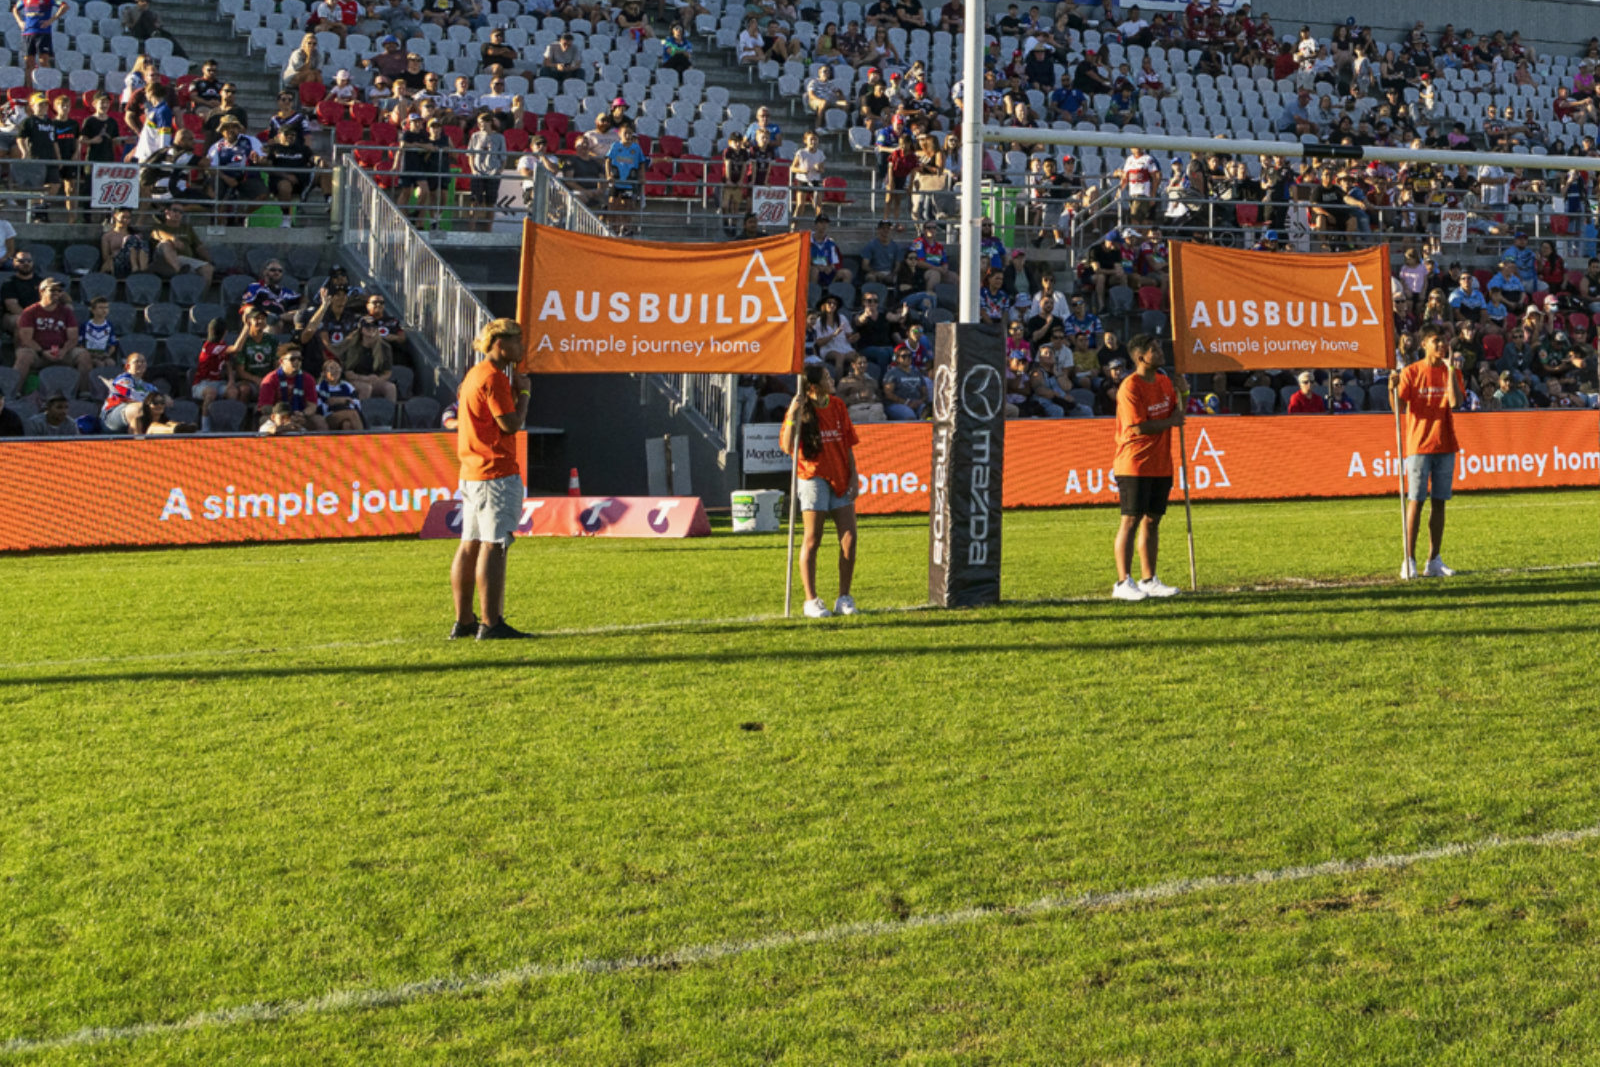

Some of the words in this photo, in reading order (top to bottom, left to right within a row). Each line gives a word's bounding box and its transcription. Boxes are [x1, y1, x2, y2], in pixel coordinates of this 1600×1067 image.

[99, 181, 132, 205] 19
[538, 290, 762, 324] AUSBUILD
[1190, 299, 1358, 328] AUSBUILD
[537, 334, 554, 351] A
[560, 334, 627, 356] simple
[631, 334, 705, 356] journey
[710, 335, 760, 353] home
[1192, 338, 1206, 354] A
[1210, 337, 1259, 356] simple
[1263, 336, 1317, 355] journey
[1320, 337, 1359, 352] home
[1348, 452, 1366, 477] A
[1458, 449, 1548, 480] journey
[1554, 447, 1600, 471] hom
[858, 472, 928, 494] ome.
[968, 430, 991, 565] mazda
[159, 488, 192, 521] A
[203, 483, 340, 525] simple
[347, 481, 461, 522] journ
